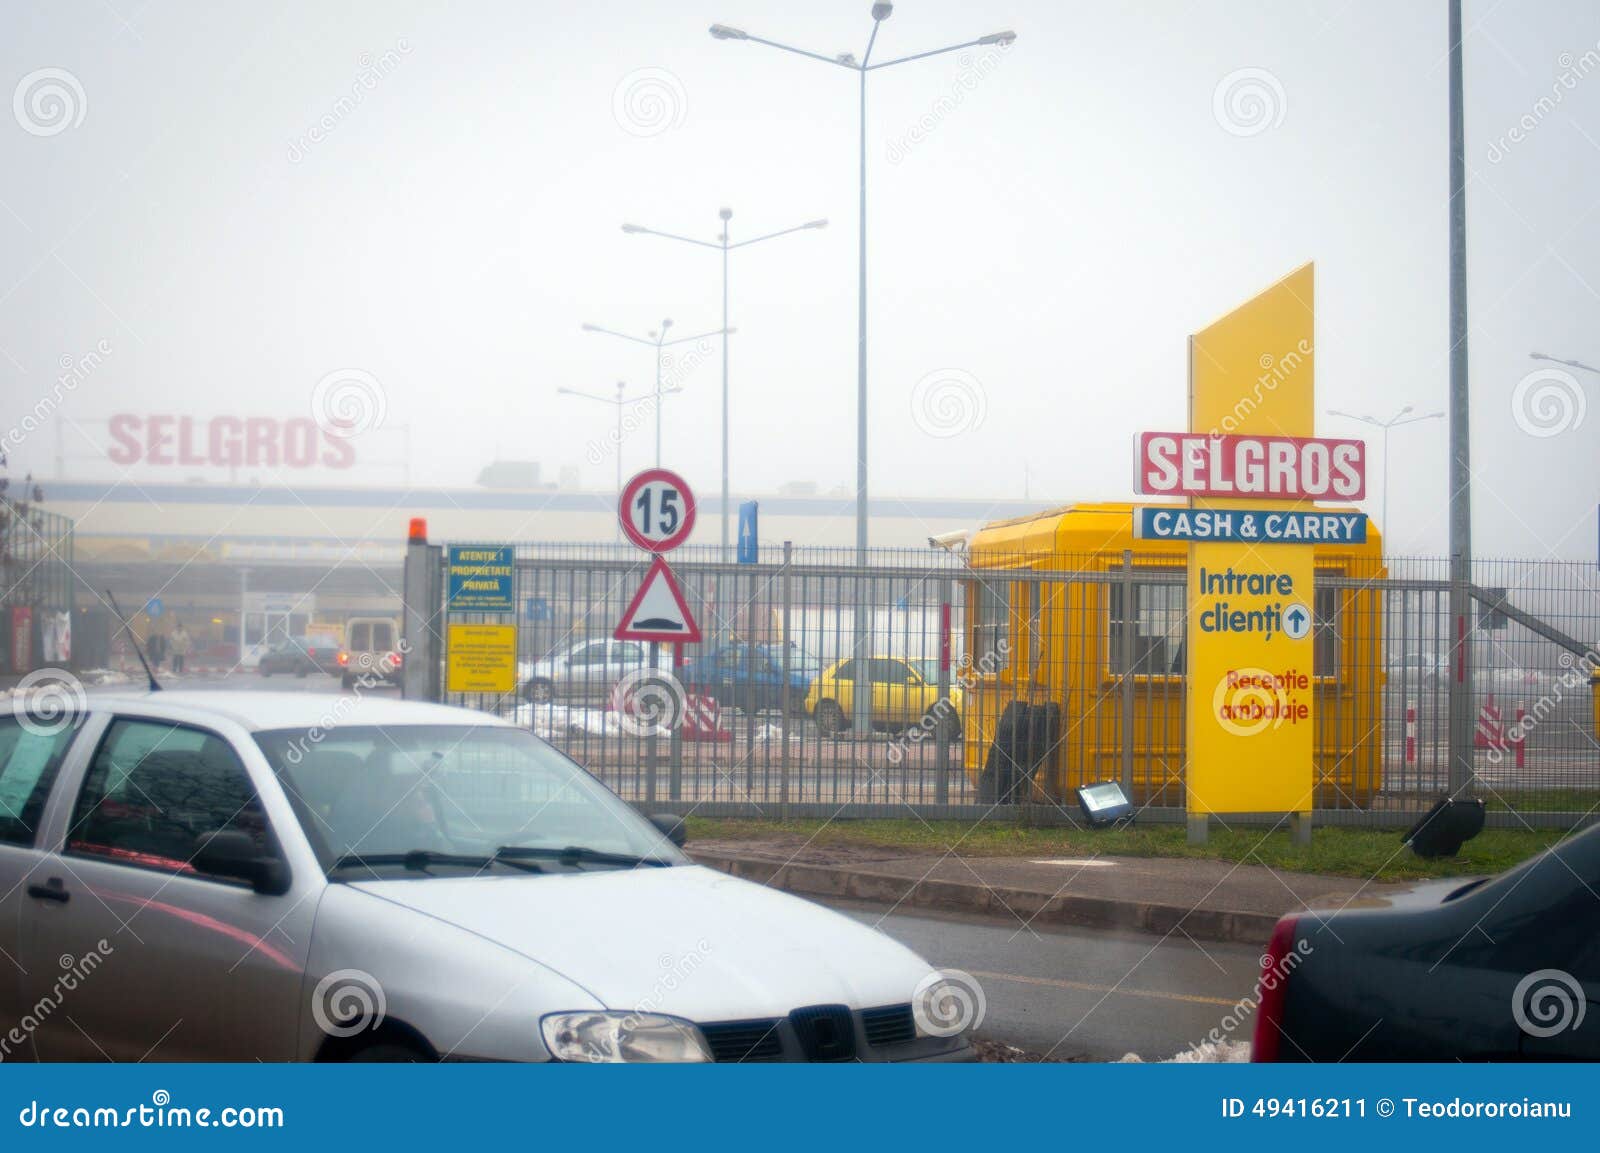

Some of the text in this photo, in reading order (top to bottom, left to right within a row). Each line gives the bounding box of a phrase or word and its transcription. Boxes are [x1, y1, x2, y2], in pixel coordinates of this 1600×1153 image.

[107, 413, 356, 469] SELGROS
[1147, 436, 1361, 496] SELGROS
[637, 488, 678, 535] 15
[1152, 512, 1358, 539] CASH & CARRY
[451, 566, 511, 576] PROPRIETATE
[1200, 568, 1293, 595] Intrare
[1220, 699, 1309, 724] ambalaje
